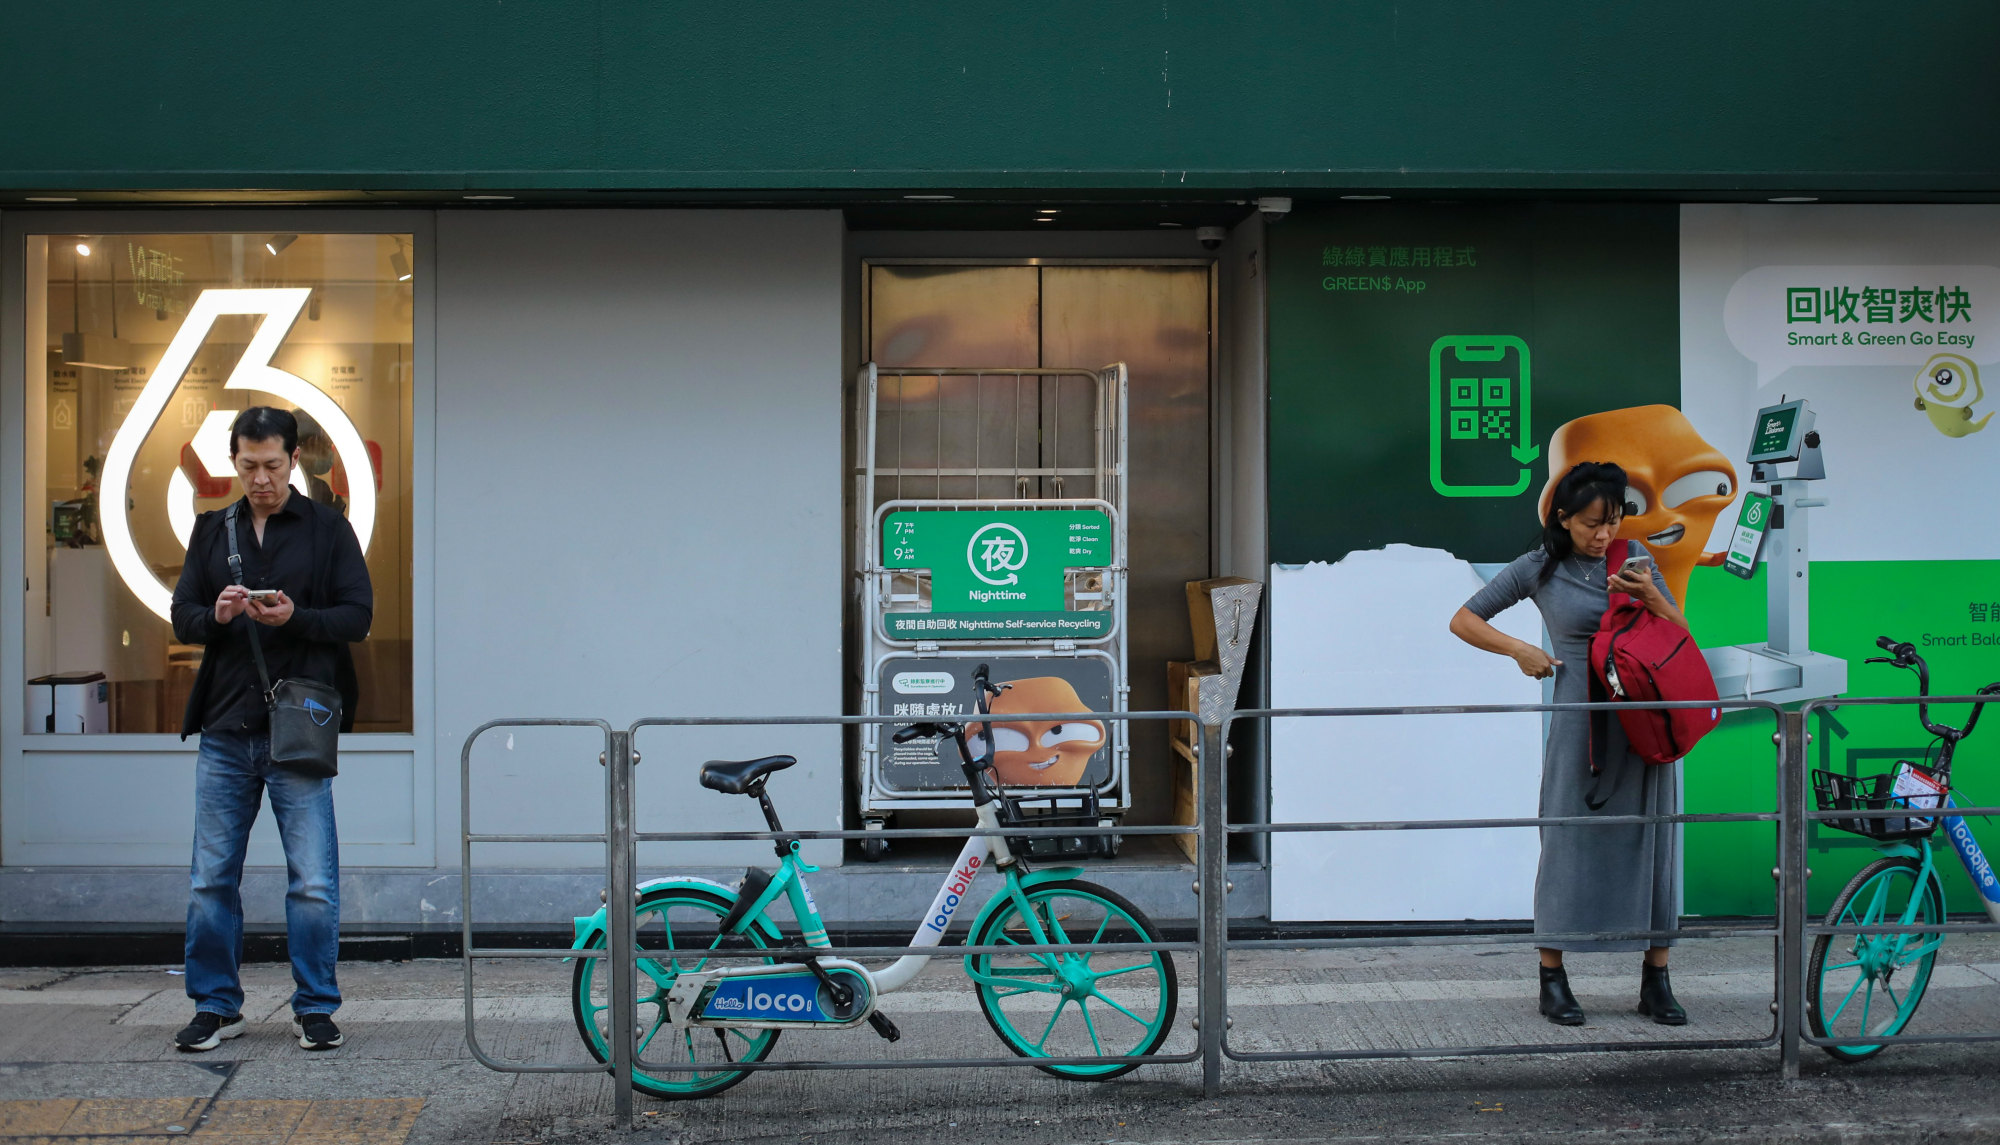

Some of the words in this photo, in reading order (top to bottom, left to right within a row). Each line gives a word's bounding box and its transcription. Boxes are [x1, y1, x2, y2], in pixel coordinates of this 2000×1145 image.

[1322, 246, 1477, 267] 綠綠賞應用程式
[1322, 275, 1392, 292] GREEN$
[1395, 276, 1426, 294] App
[1786, 286, 1972, 324] 回收智爽快
[1787, 331, 1838, 346] Smart
[1841, 332, 1854, 346] &
[1857, 331, 1906, 346] Green
[1910, 331, 1934, 346] Go
[1937, 332, 1976, 349] Easy
[981, 536, 1016, 572] 夜
[1082, 548, 1092, 556] Dry
[969, 589, 1027, 603] Nighttime
[896, 619, 957, 630] 夜間自助回收
[959, 620, 1004, 631] Nighttime
[1005, 619, 1056, 629] Self-service
[1058, 618, 1101, 630] Recycling
[1922, 633, 1967, 646] Smart
[1953, 820, 1994, 887] locobike
[926, 855, 982, 933] locobike
[714, 996, 744, 1010] Hello
